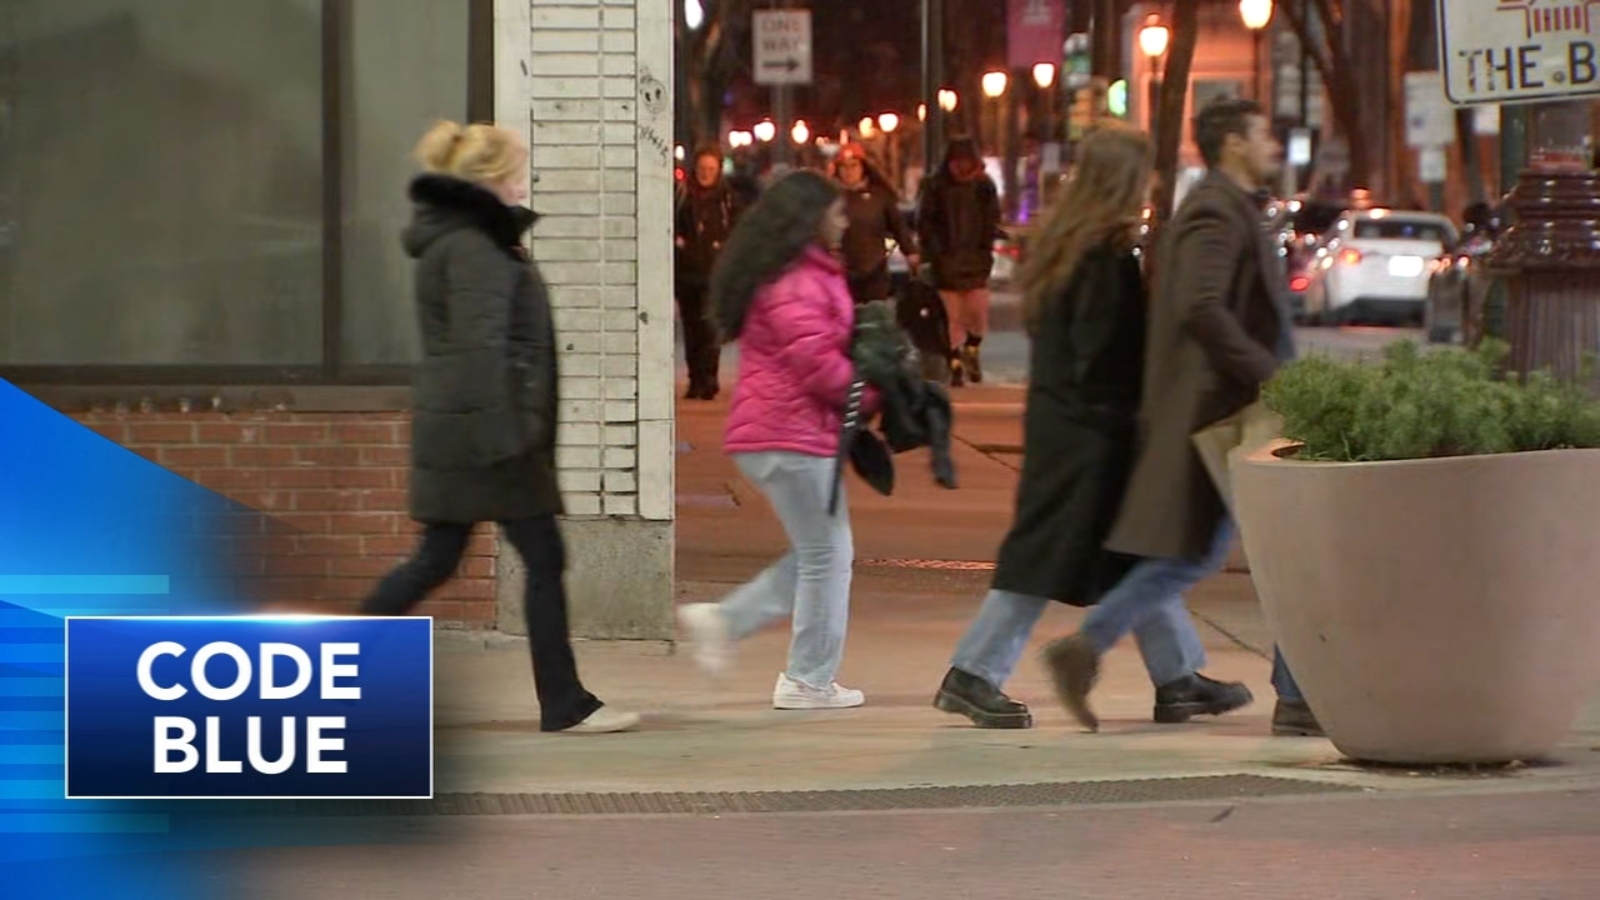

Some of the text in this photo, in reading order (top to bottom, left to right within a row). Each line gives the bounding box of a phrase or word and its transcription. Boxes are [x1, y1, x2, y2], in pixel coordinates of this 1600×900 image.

[762, 19, 800, 33] ONE
[762, 37, 800, 53] WAY
[1458, 45, 1544, 92] THE
